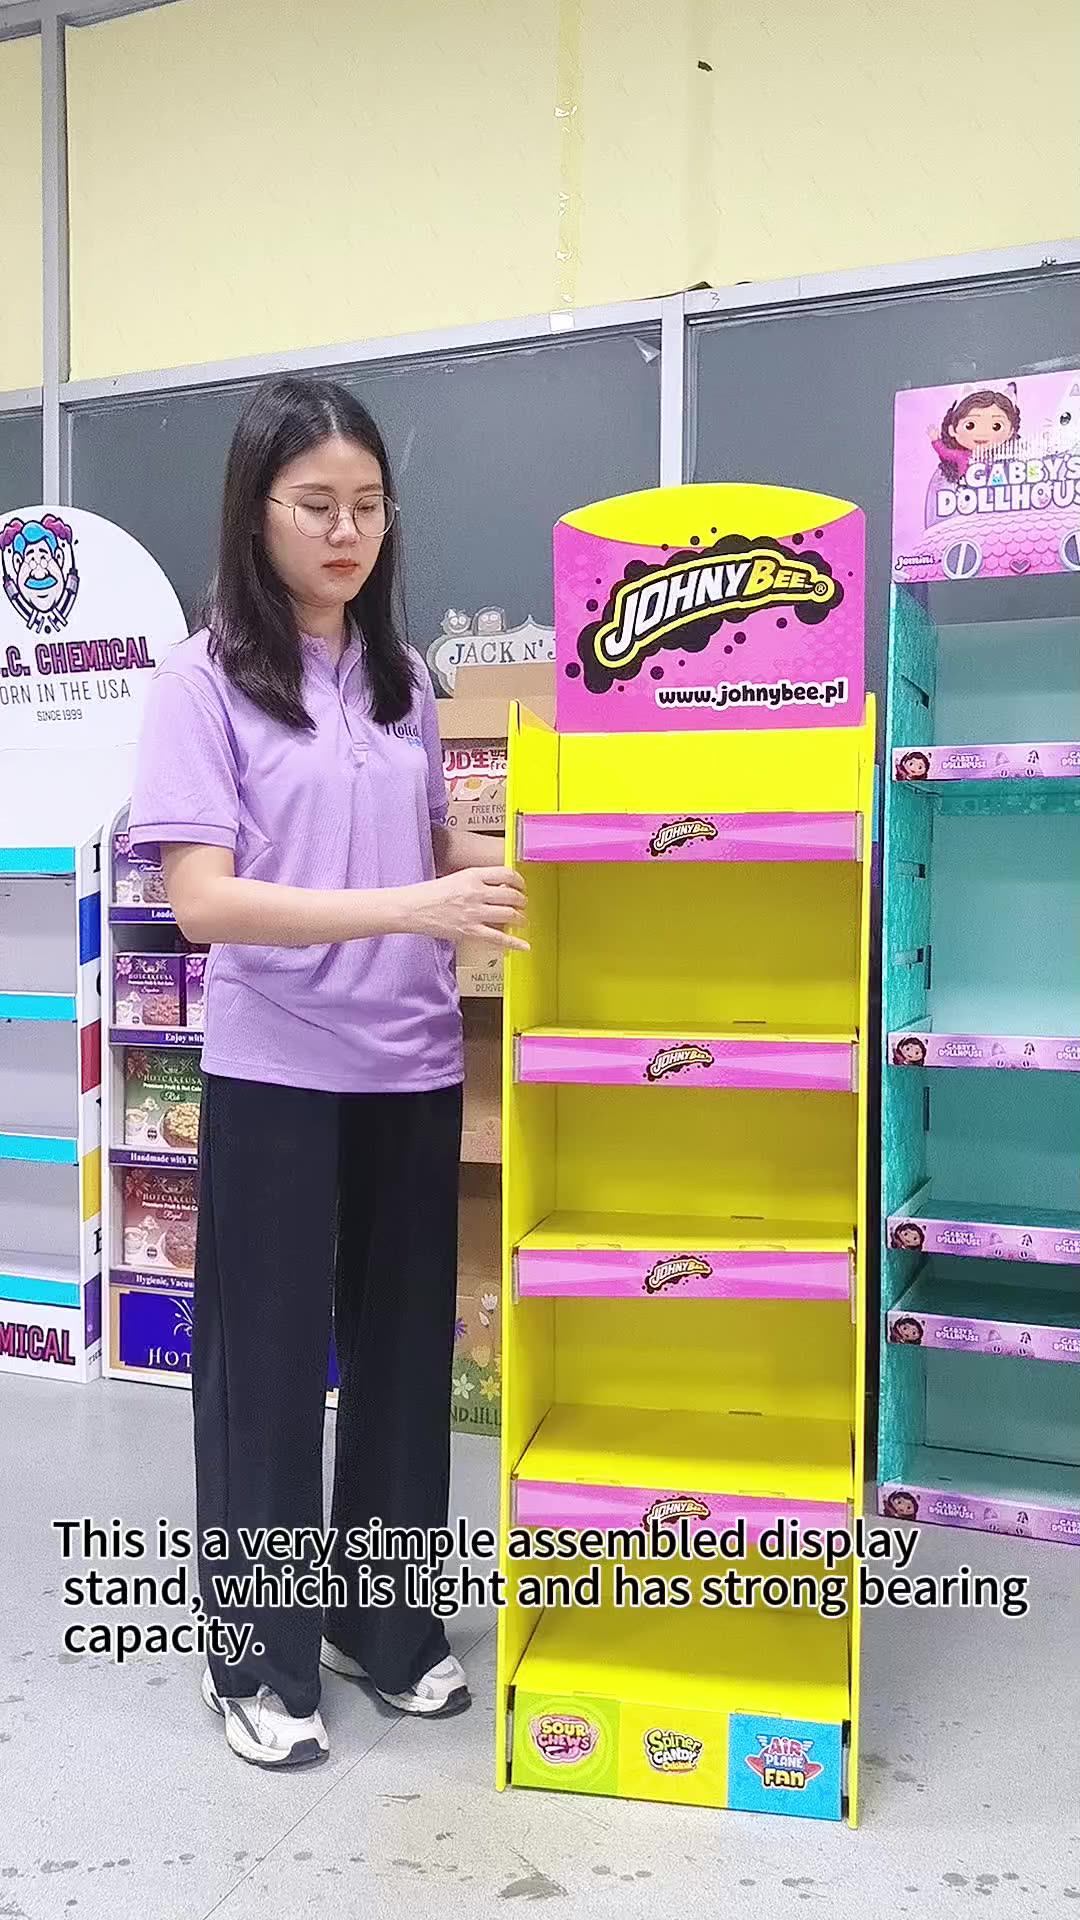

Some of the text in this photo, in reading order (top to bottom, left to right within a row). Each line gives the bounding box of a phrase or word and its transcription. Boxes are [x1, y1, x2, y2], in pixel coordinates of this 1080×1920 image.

[35, 636, 156, 675] CHEMICAL
[449, 640, 516, 665] JACK
[36, 683, 56, 703] IN
[60, 681, 91, 702] THE
[97, 679, 131, 700] USA
[658, 681, 845, 706] www.johnybee.pl
[36, 709, 83, 722] SINCE 1999
[165, 1033, 186, 1043] Enjoy
[131, 1152, 170, 1162] Handmade
[170, 1154, 186, 1163] with
[540, 1719, 586, 1738] SOUR
[537, 1734, 591, 1750] CHEWS
[763, 1752, 805, 1769] PLANE
